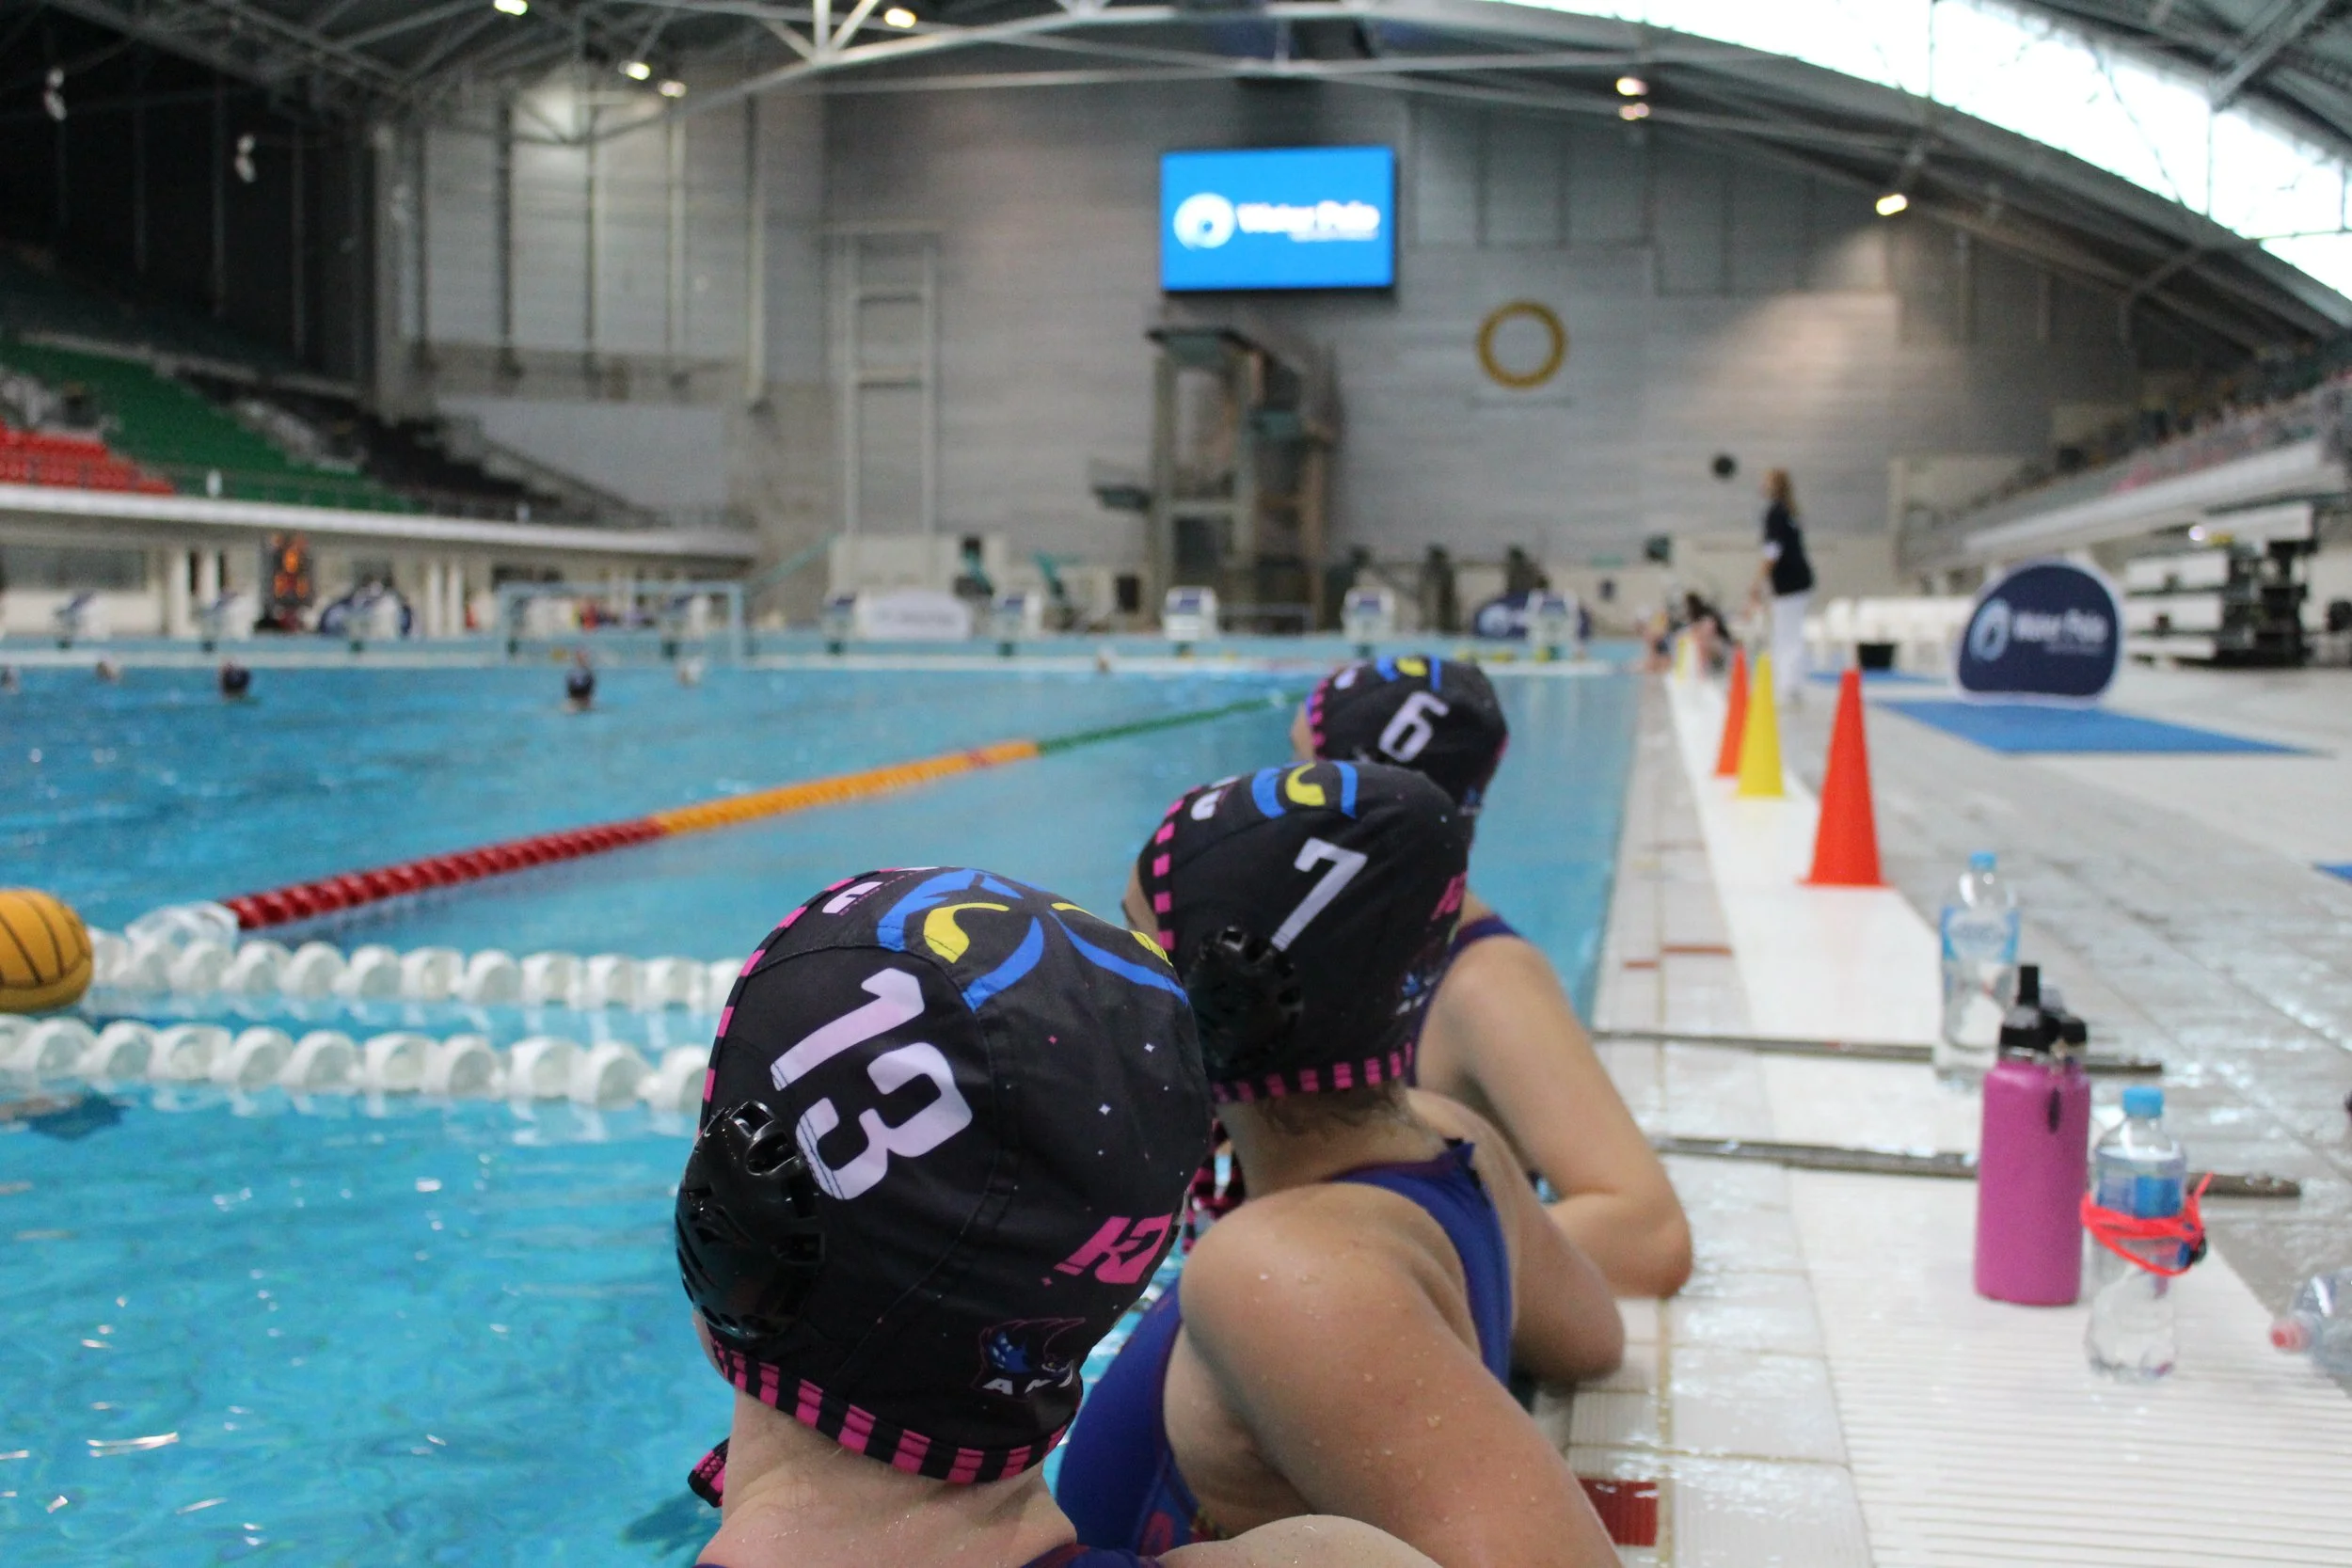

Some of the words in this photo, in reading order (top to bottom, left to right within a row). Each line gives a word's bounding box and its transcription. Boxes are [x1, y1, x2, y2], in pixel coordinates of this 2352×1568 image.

[1378, 691, 1450, 763] 6
[1271, 837, 1369, 952] 7
[770, 967, 973, 1200] 13
